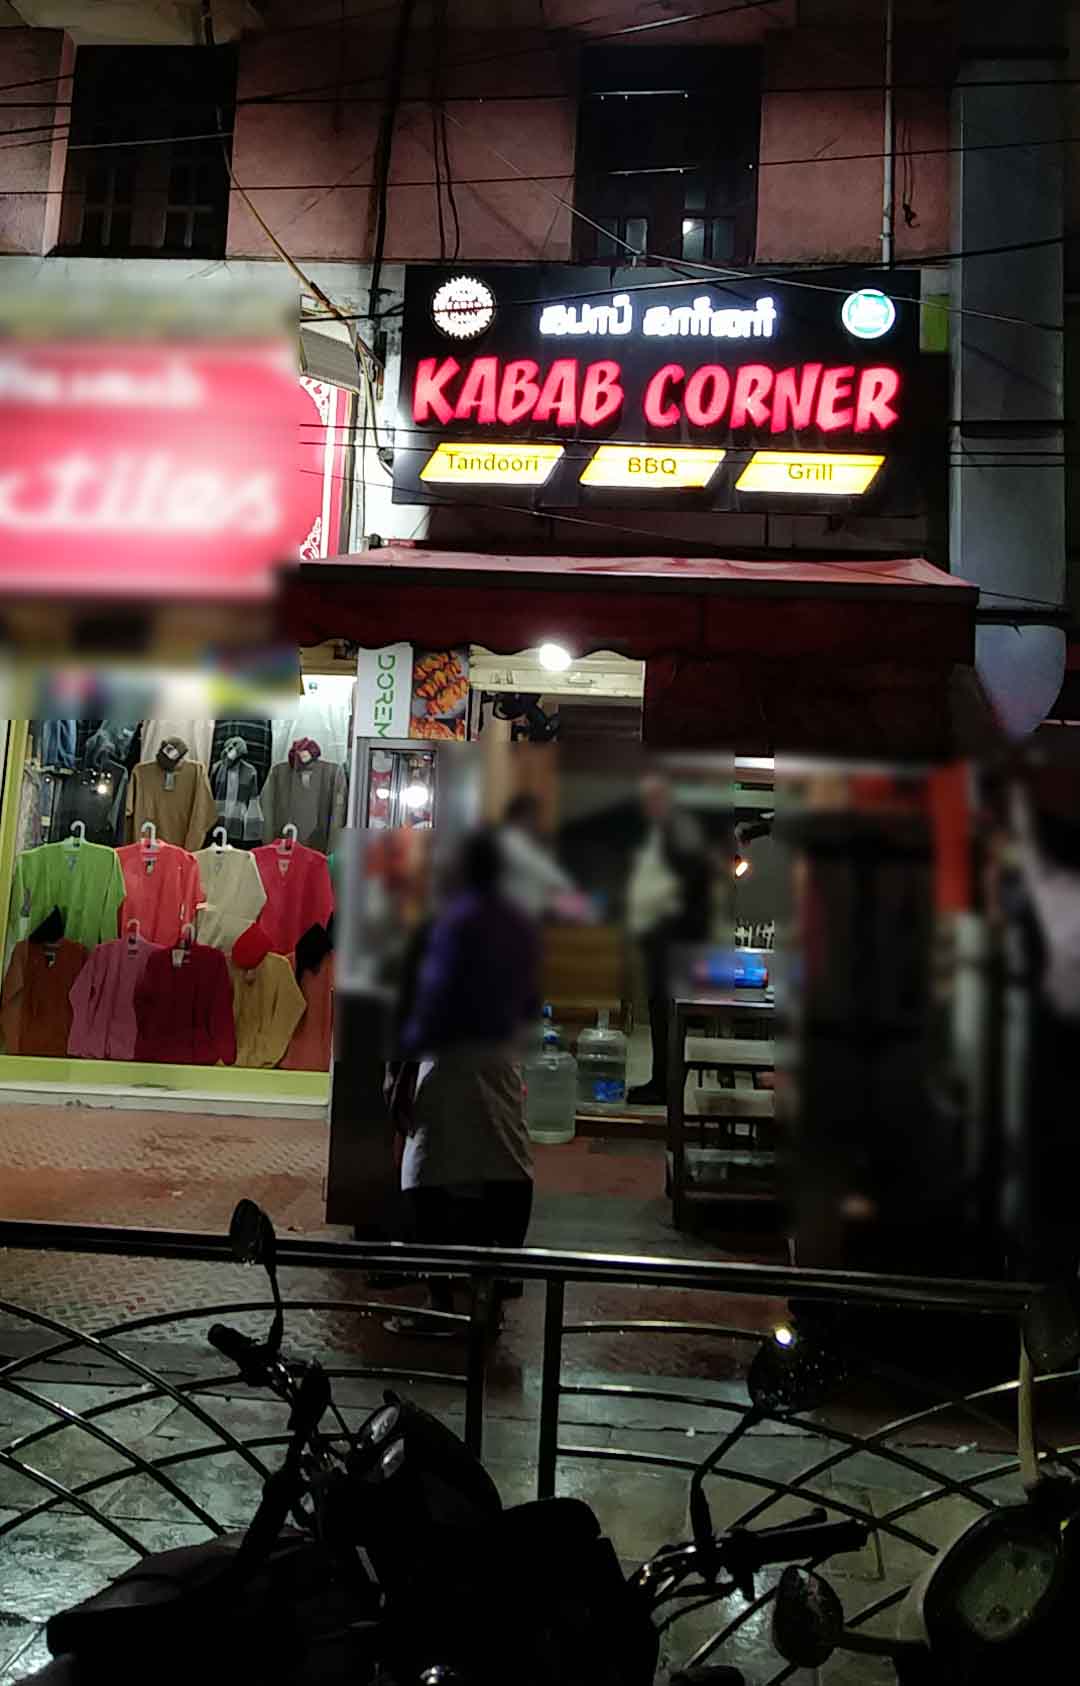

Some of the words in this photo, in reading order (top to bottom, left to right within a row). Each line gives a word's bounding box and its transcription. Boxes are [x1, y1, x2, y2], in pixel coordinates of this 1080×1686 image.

[412, 357, 624, 427] KABAB
[644, 363, 900, 433] CORNER
[446, 453, 539, 472] Tandoori
[627, 457, 677, 475] BBQ
[788, 463, 834, 482] Grill
